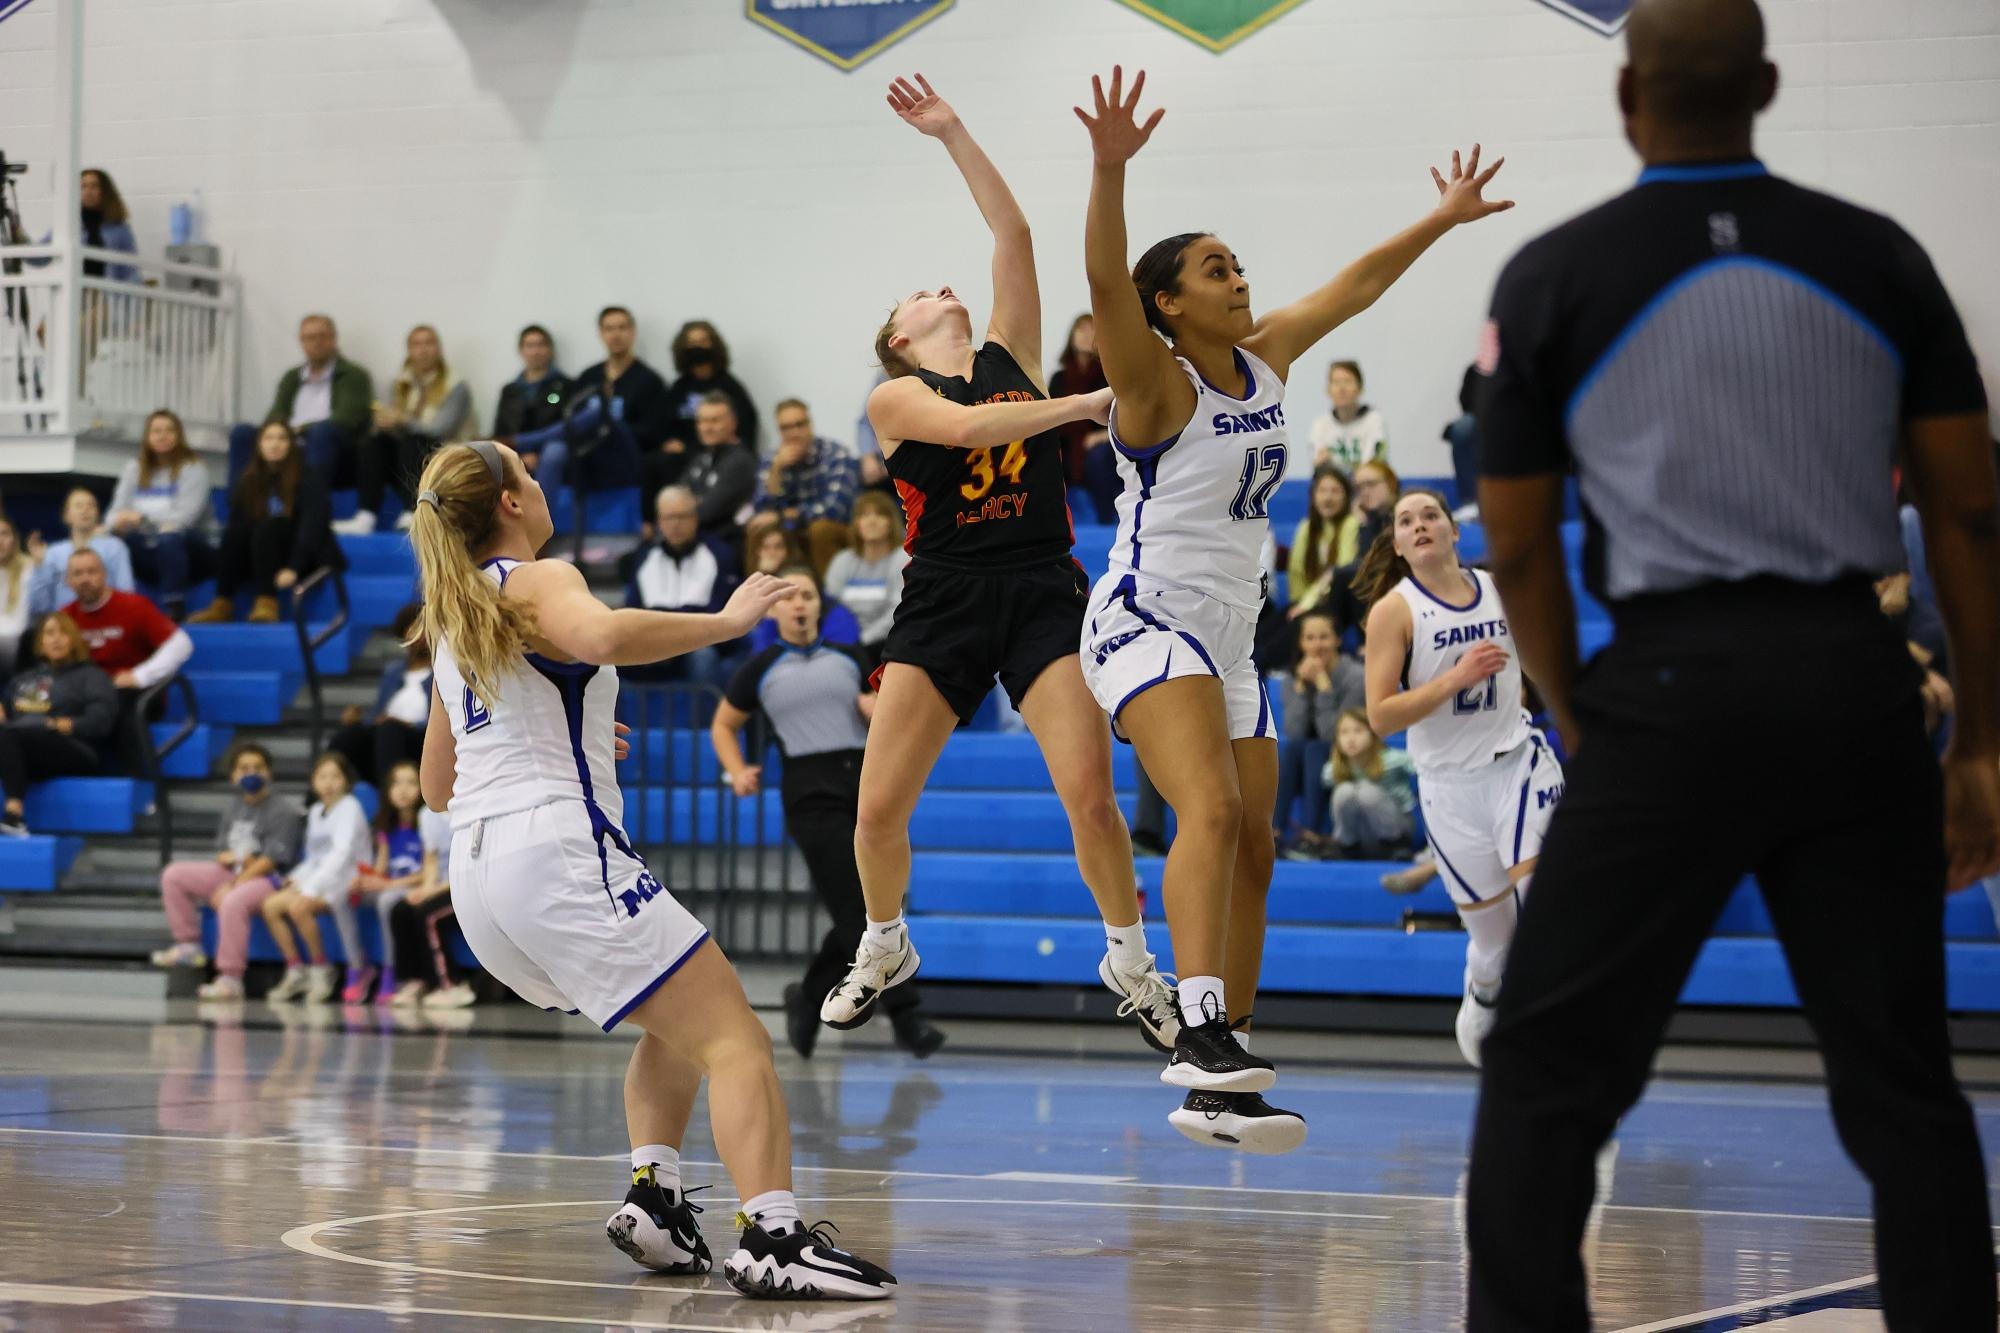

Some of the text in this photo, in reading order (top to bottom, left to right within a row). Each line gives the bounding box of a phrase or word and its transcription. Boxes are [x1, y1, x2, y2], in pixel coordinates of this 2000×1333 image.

[961, 440, 1028, 501] 34
[1229, 443, 1288, 521] 12
[1434, 619, 1508, 650] SAINTS
